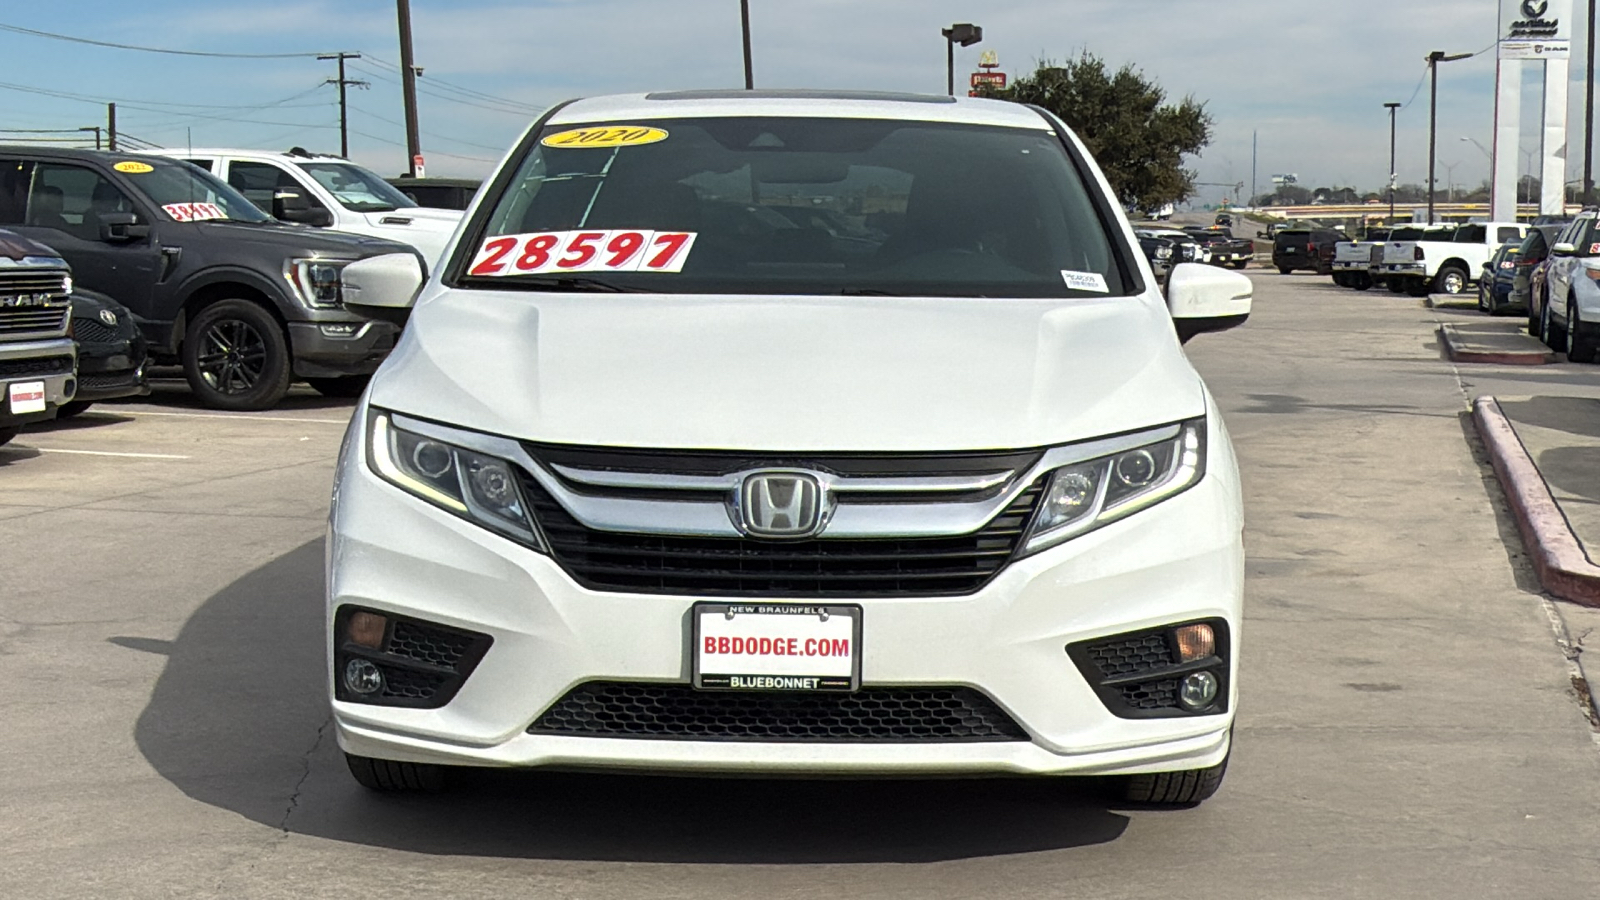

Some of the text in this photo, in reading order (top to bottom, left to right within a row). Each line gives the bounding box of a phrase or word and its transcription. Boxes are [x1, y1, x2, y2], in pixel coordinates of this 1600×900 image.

[557, 129, 651, 144] 2020
[470, 232, 690, 275] 28597
[758, 606, 825, 615] BRAUNFELS
[704, 636, 849, 657] BBDODGE.COM
[730, 676, 820, 689] BLUEBONNET
